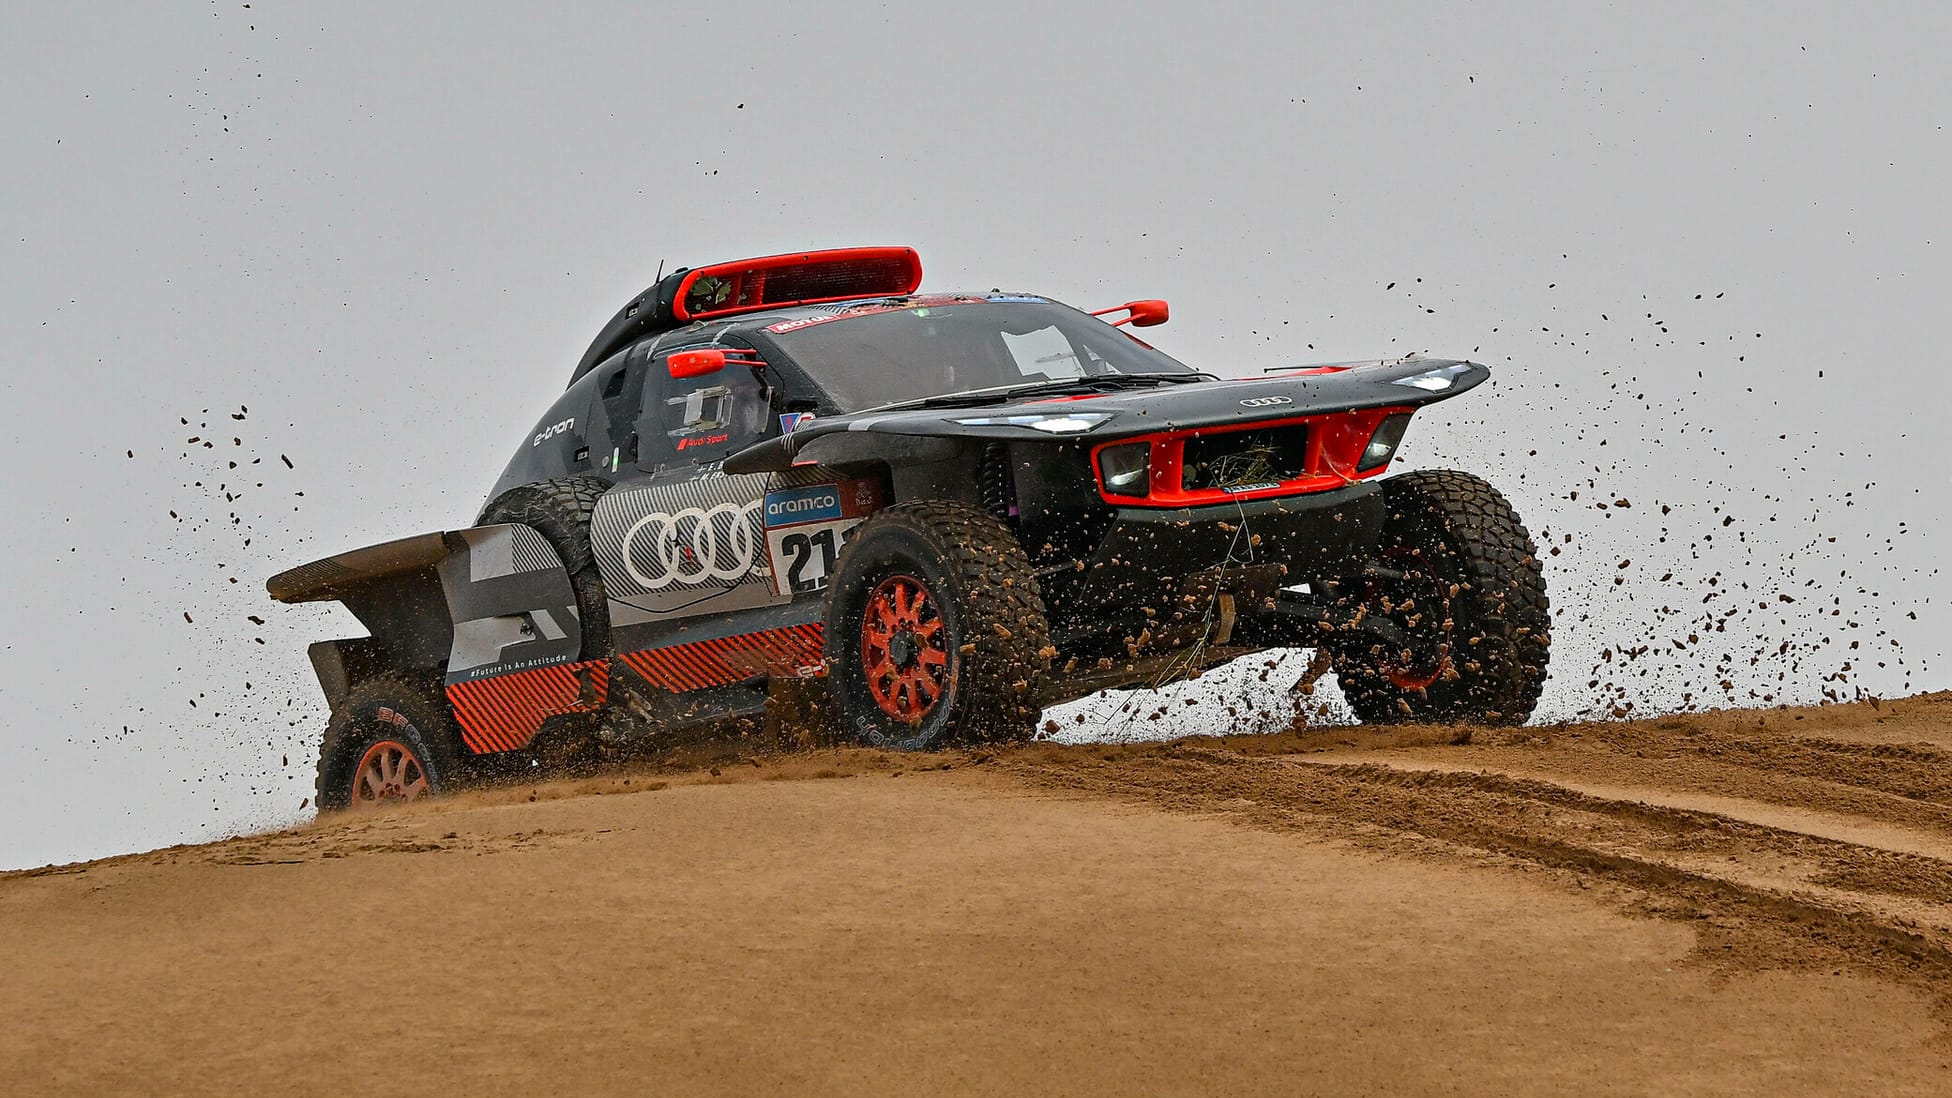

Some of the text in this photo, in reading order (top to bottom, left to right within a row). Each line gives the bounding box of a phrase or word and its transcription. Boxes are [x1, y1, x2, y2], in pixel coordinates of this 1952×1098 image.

[533, 417, 575, 447] e-tron
[687, 433, 729, 447] Audi Sport
[768, 495, 835, 515] aramco
[781, 527, 864, 593] 21
[470, 654, 567, 677] #Future Is An Attitude
